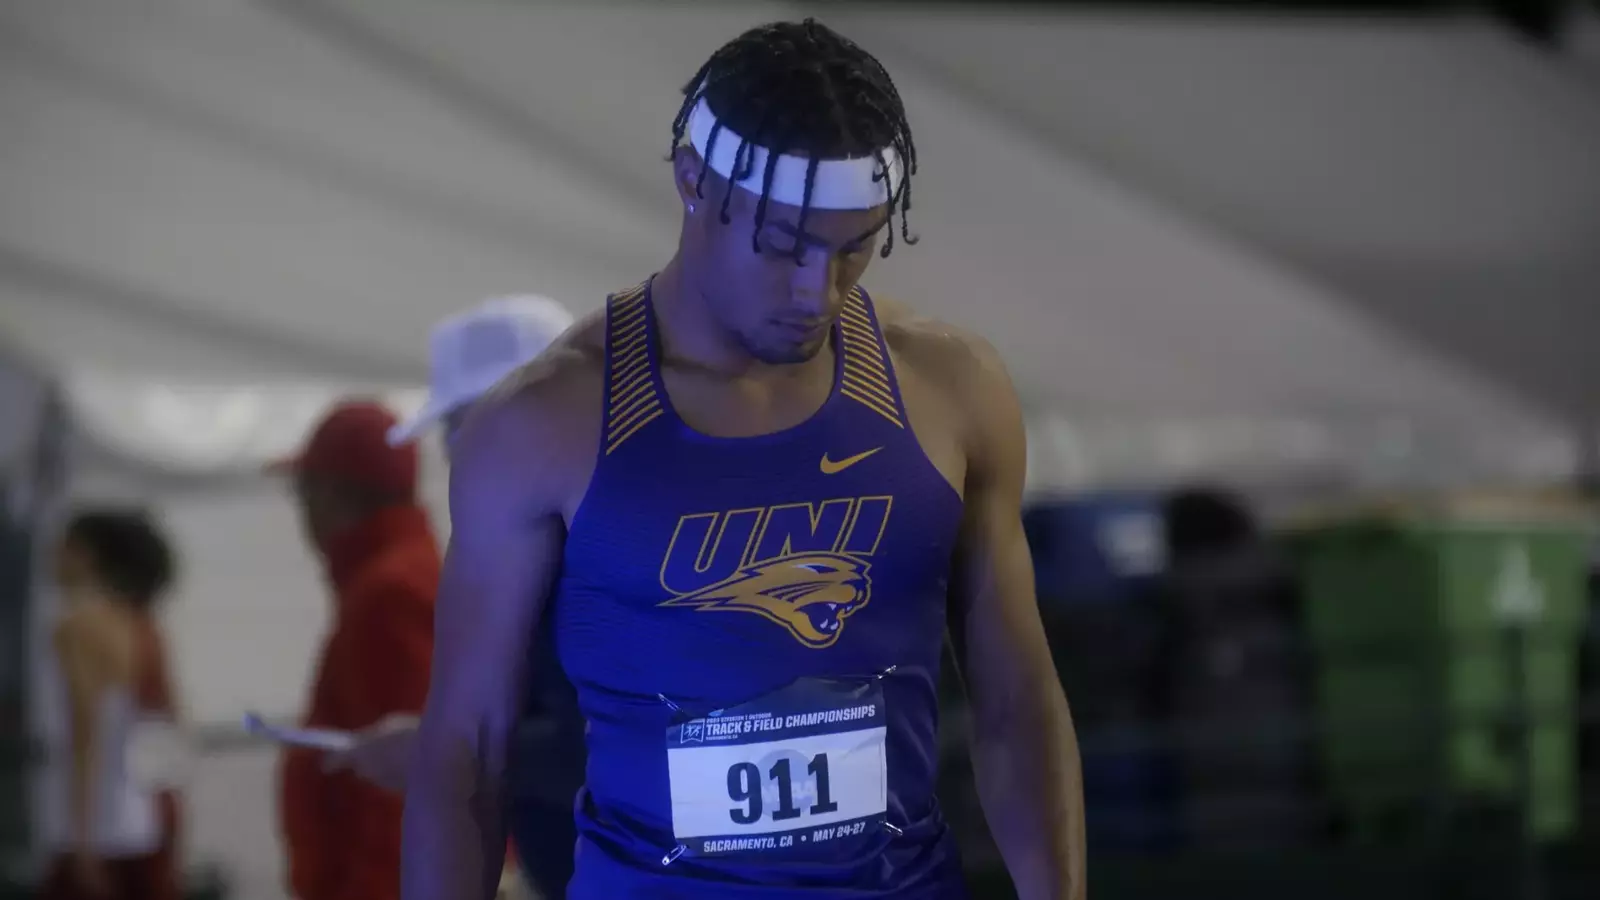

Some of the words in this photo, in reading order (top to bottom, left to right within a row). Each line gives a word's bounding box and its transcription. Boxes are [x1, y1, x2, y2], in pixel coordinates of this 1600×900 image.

[659, 495, 893, 595] UNI
[706, 721, 742, 735] TRACK
[743, 720, 752, 732] &
[753, 717, 784, 732] FIELD
[785, 704, 876, 728] CHAMPIONSHIPS
[726, 753, 838, 825] 911
[703, 837, 777, 853] SACRAMENTO,
[779, 835, 793, 847] CA
[812, 828, 835, 843] MAY
[836, 822, 866, 839] 24-27
